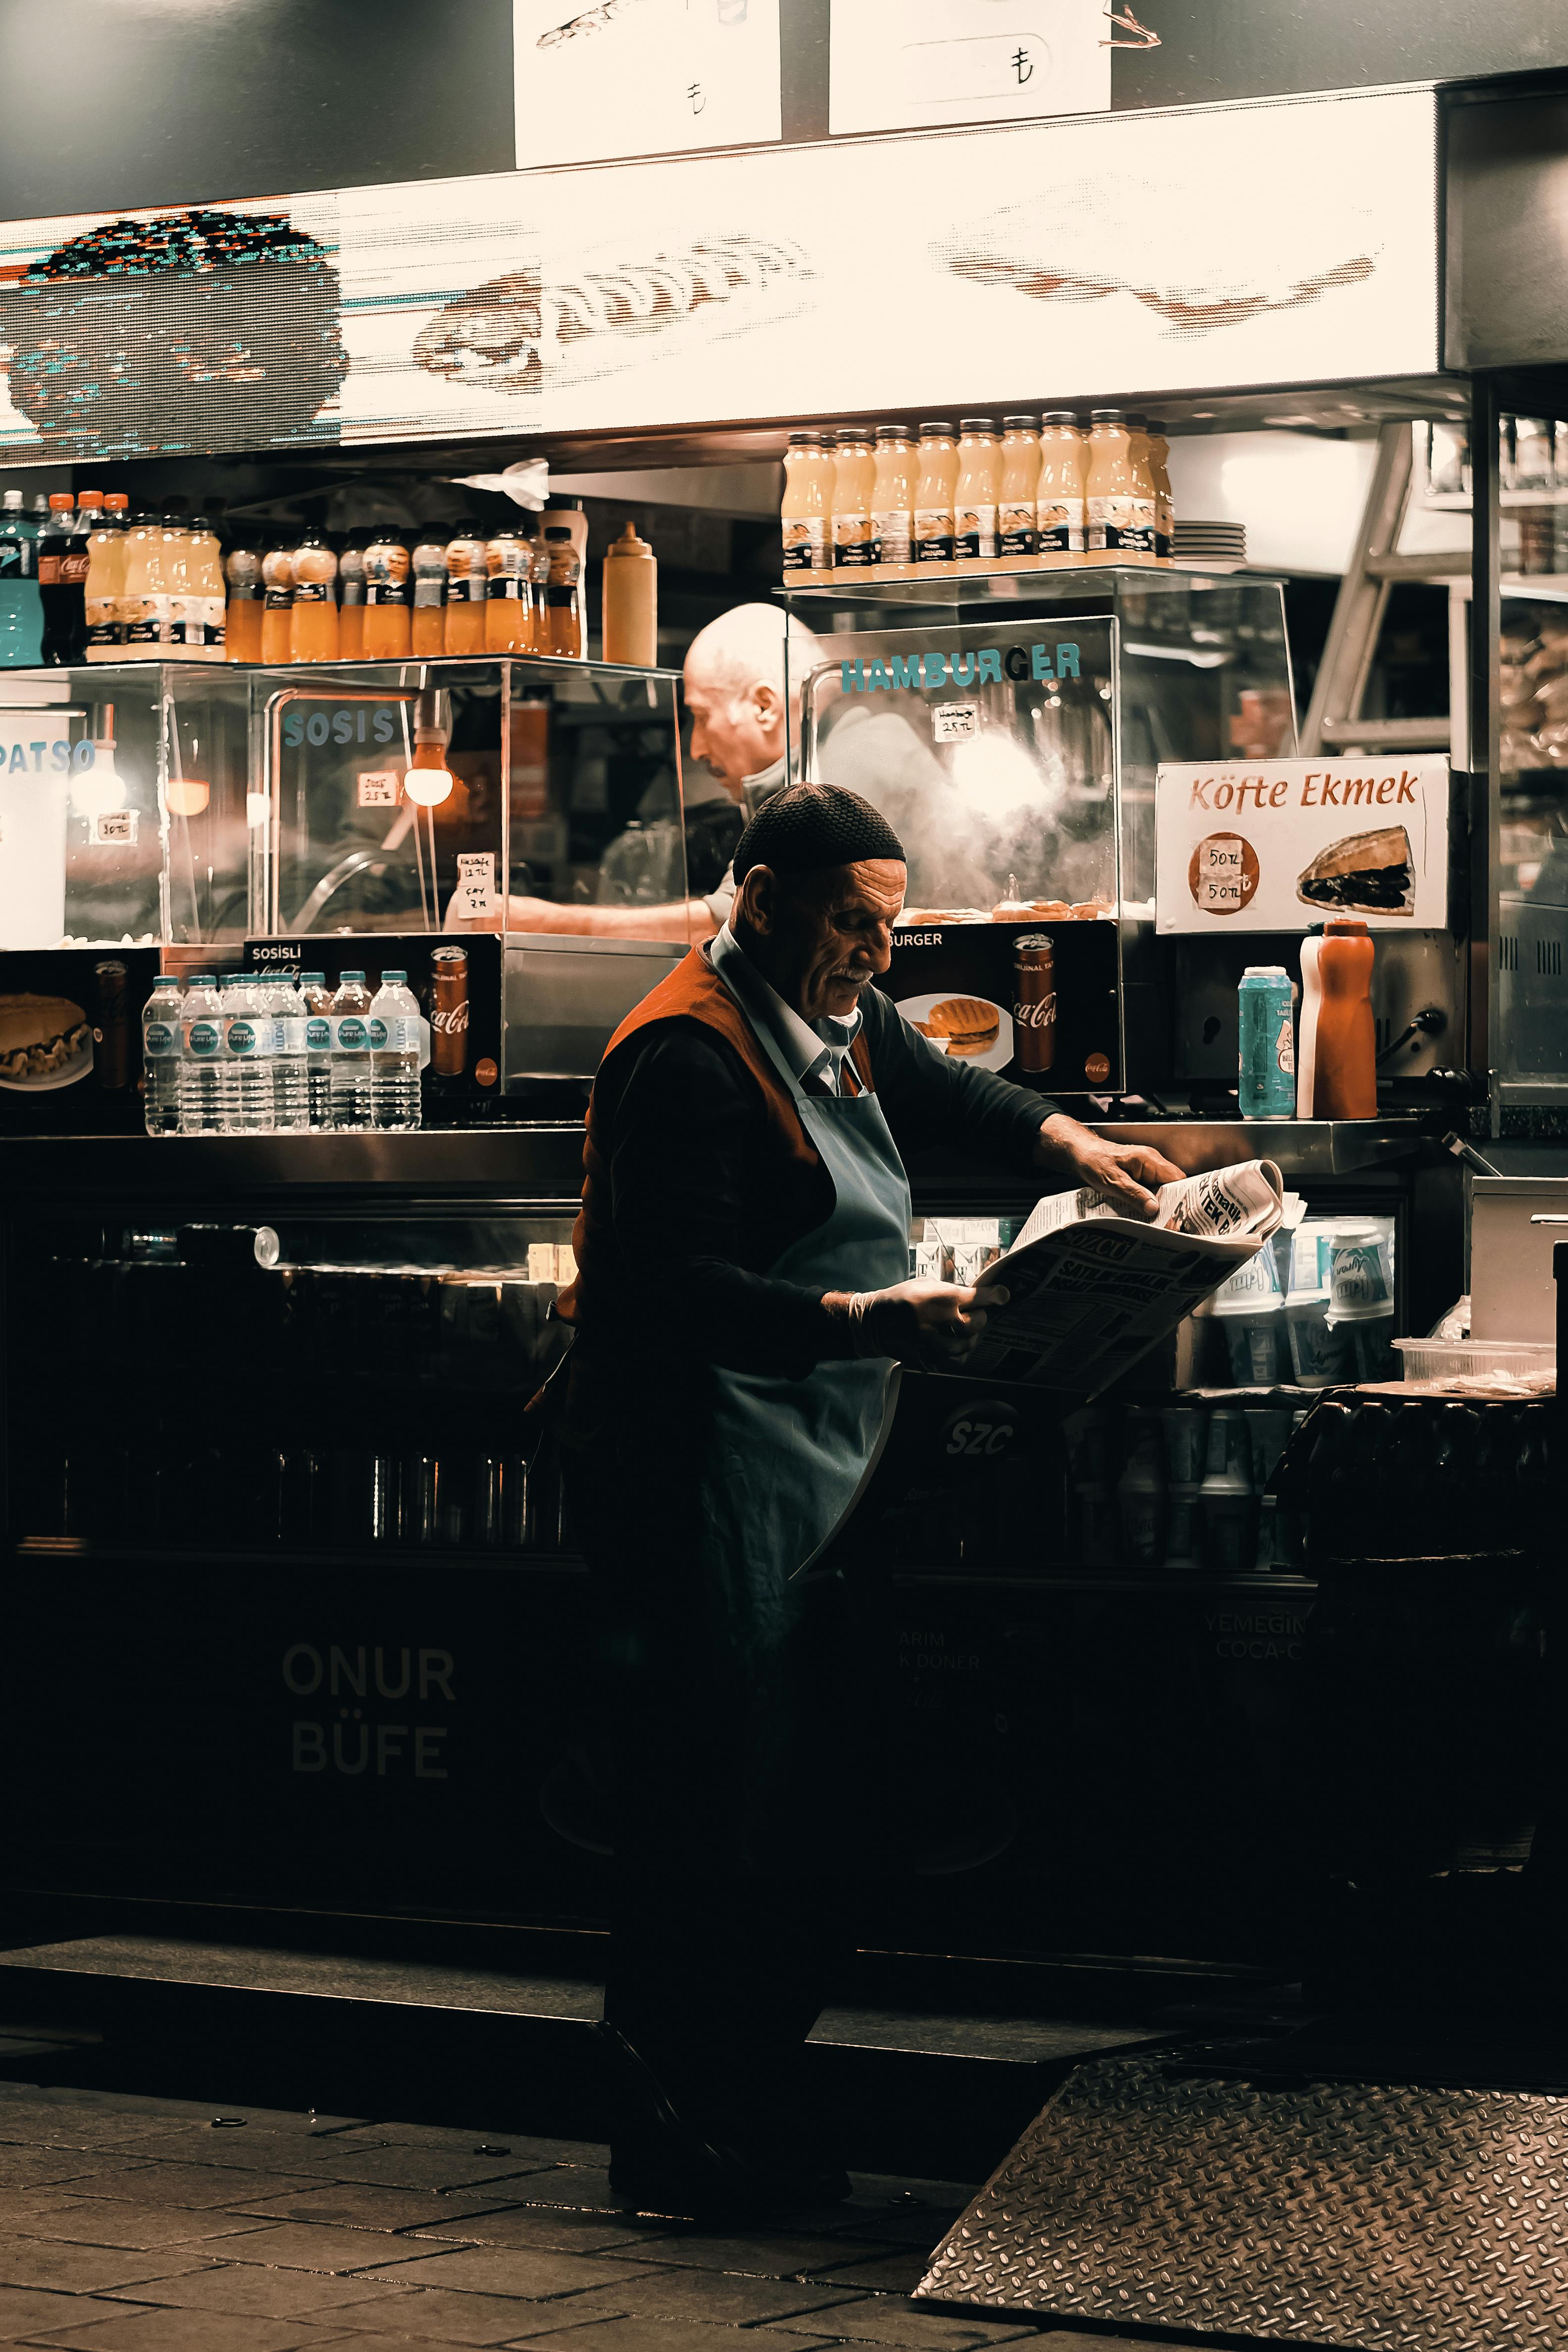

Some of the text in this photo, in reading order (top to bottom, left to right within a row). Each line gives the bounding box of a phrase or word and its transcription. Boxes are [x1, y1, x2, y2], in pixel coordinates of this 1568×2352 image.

[841, 643, 1080, 693] HAMBURGER
[1189, 769, 1419, 815] Köfte Ekmek
[253, 944, 301, 960] SOSİSLİ
[946, 1420, 1013, 1455] SZC
[282, 1643, 456, 1701] ONUR
[293, 1706, 449, 1779] BÜFE
